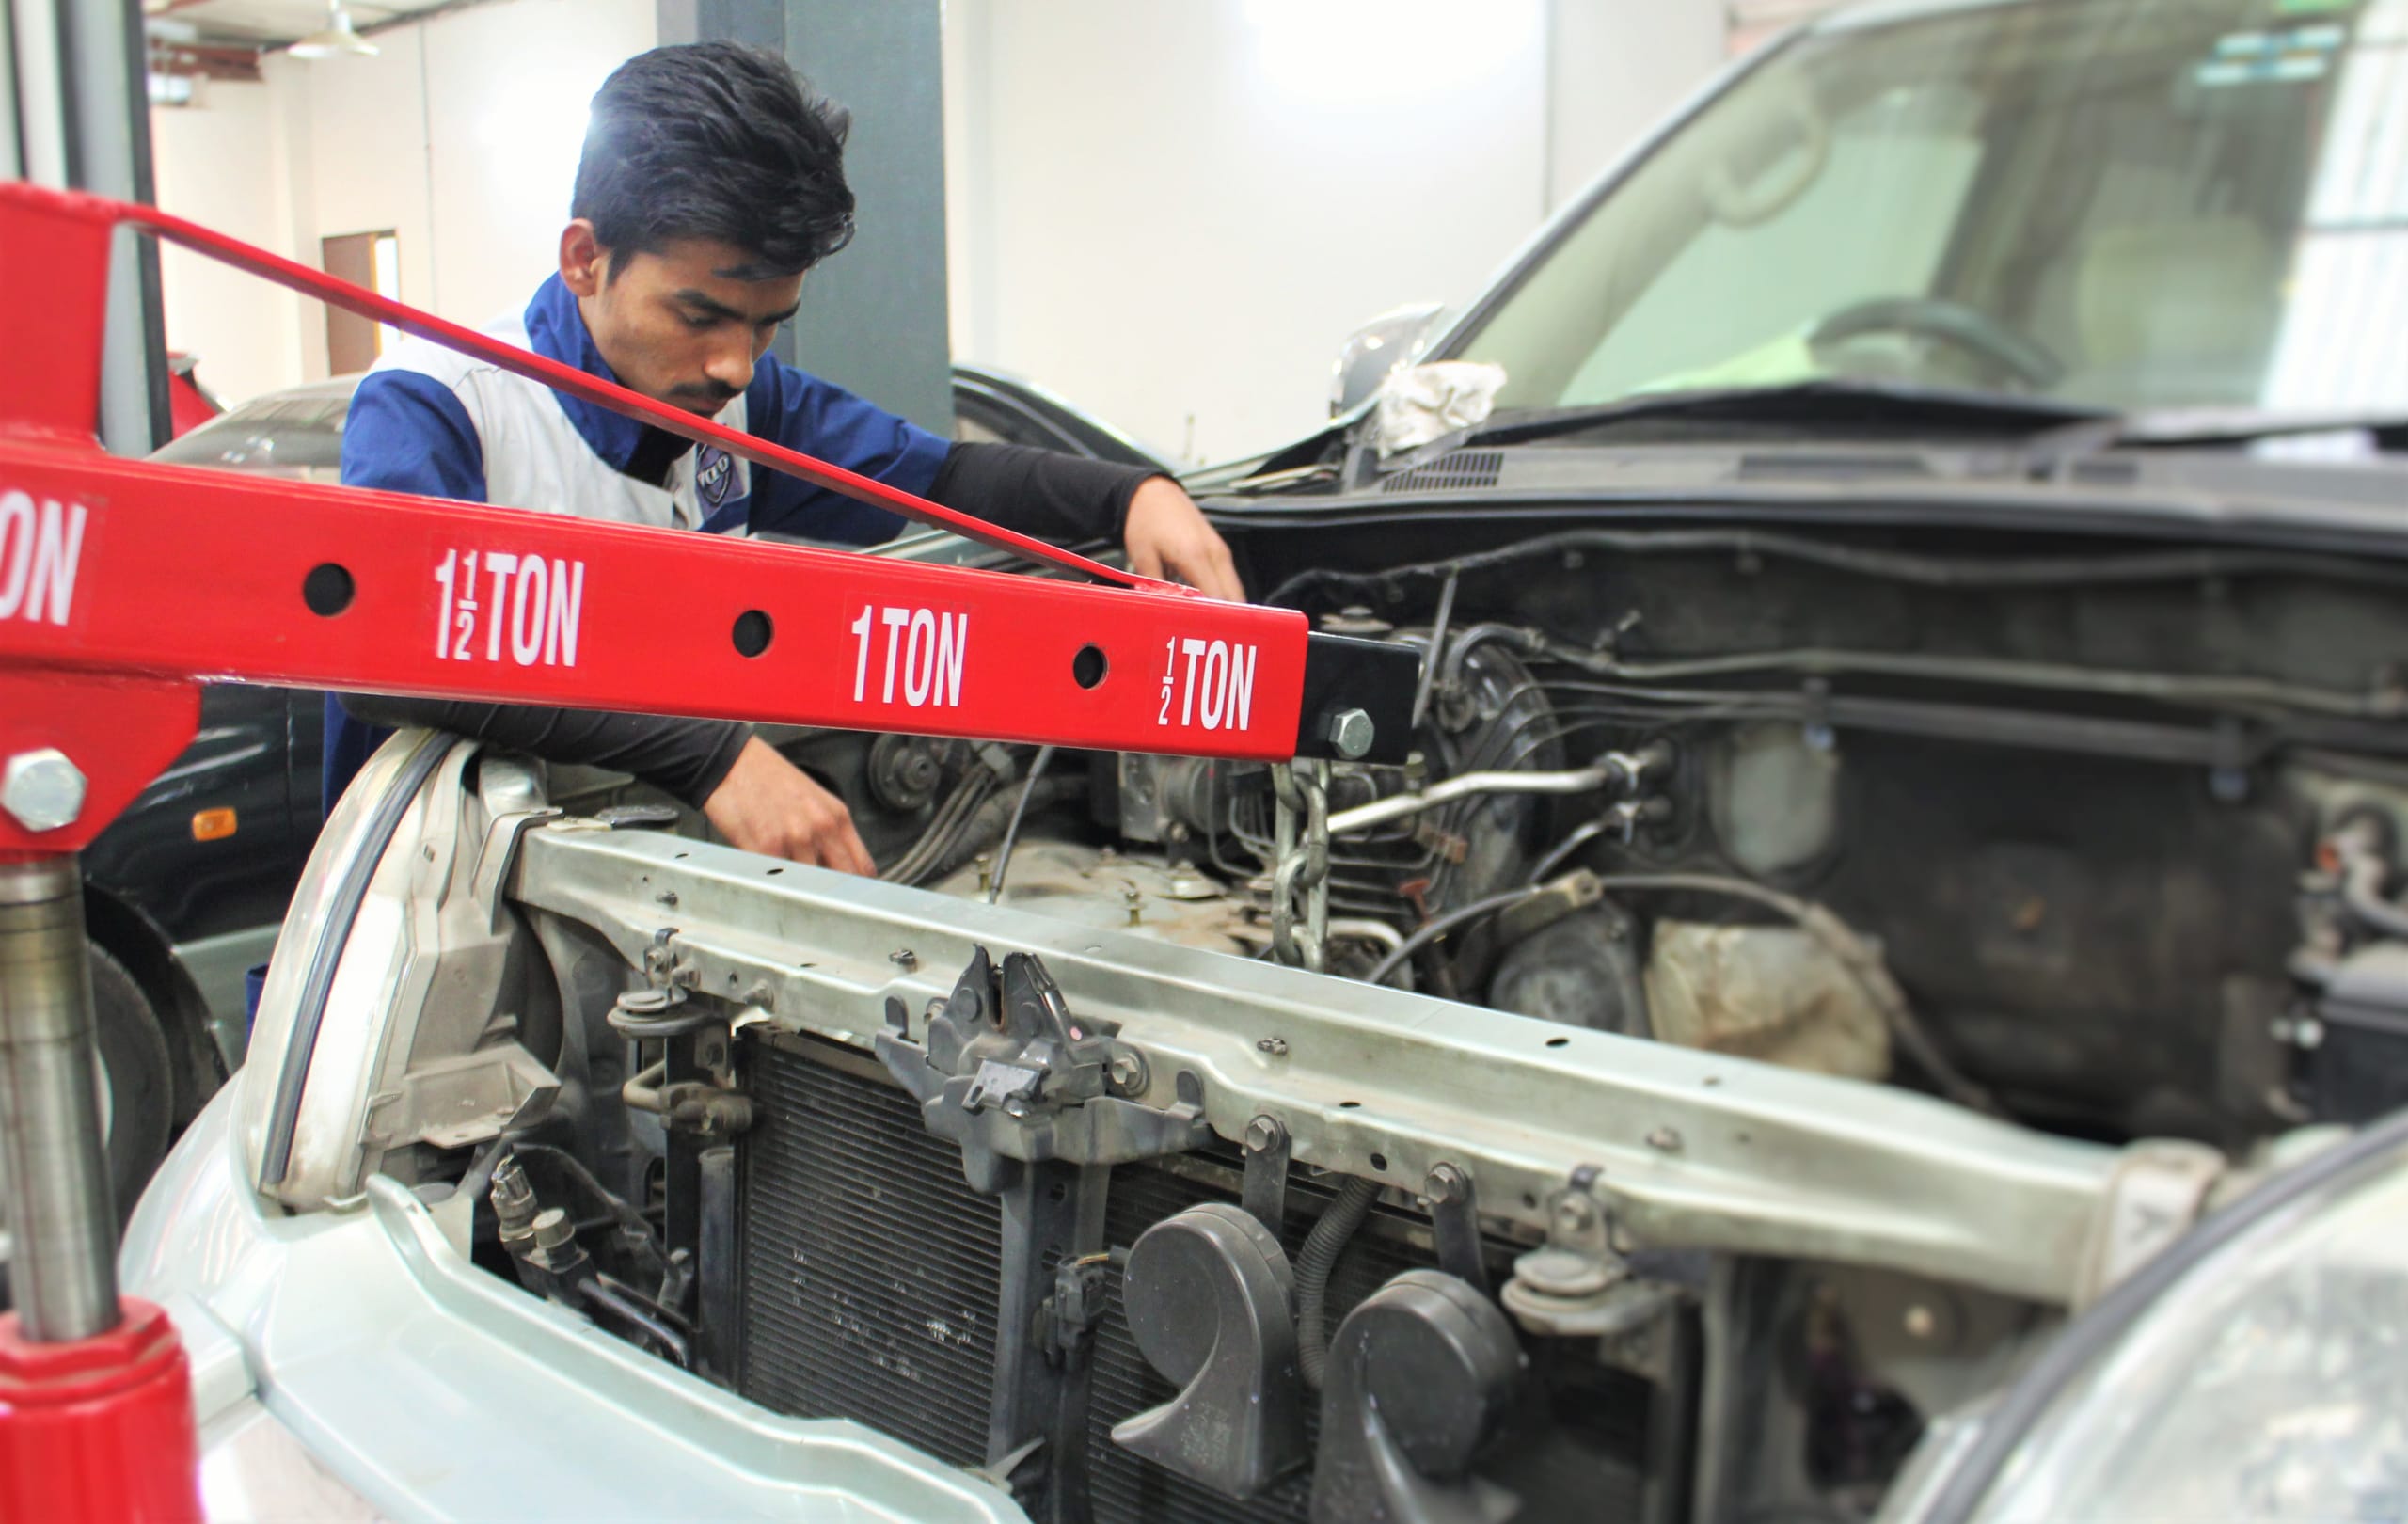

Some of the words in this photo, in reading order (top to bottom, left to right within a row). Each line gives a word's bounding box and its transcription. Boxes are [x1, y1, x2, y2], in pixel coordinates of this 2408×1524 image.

[484, 550, 585, 667] TON
[851, 604, 873, 703] 1
[881, 607, 968, 708] TON
[1181, 638, 1257, 732] TON
